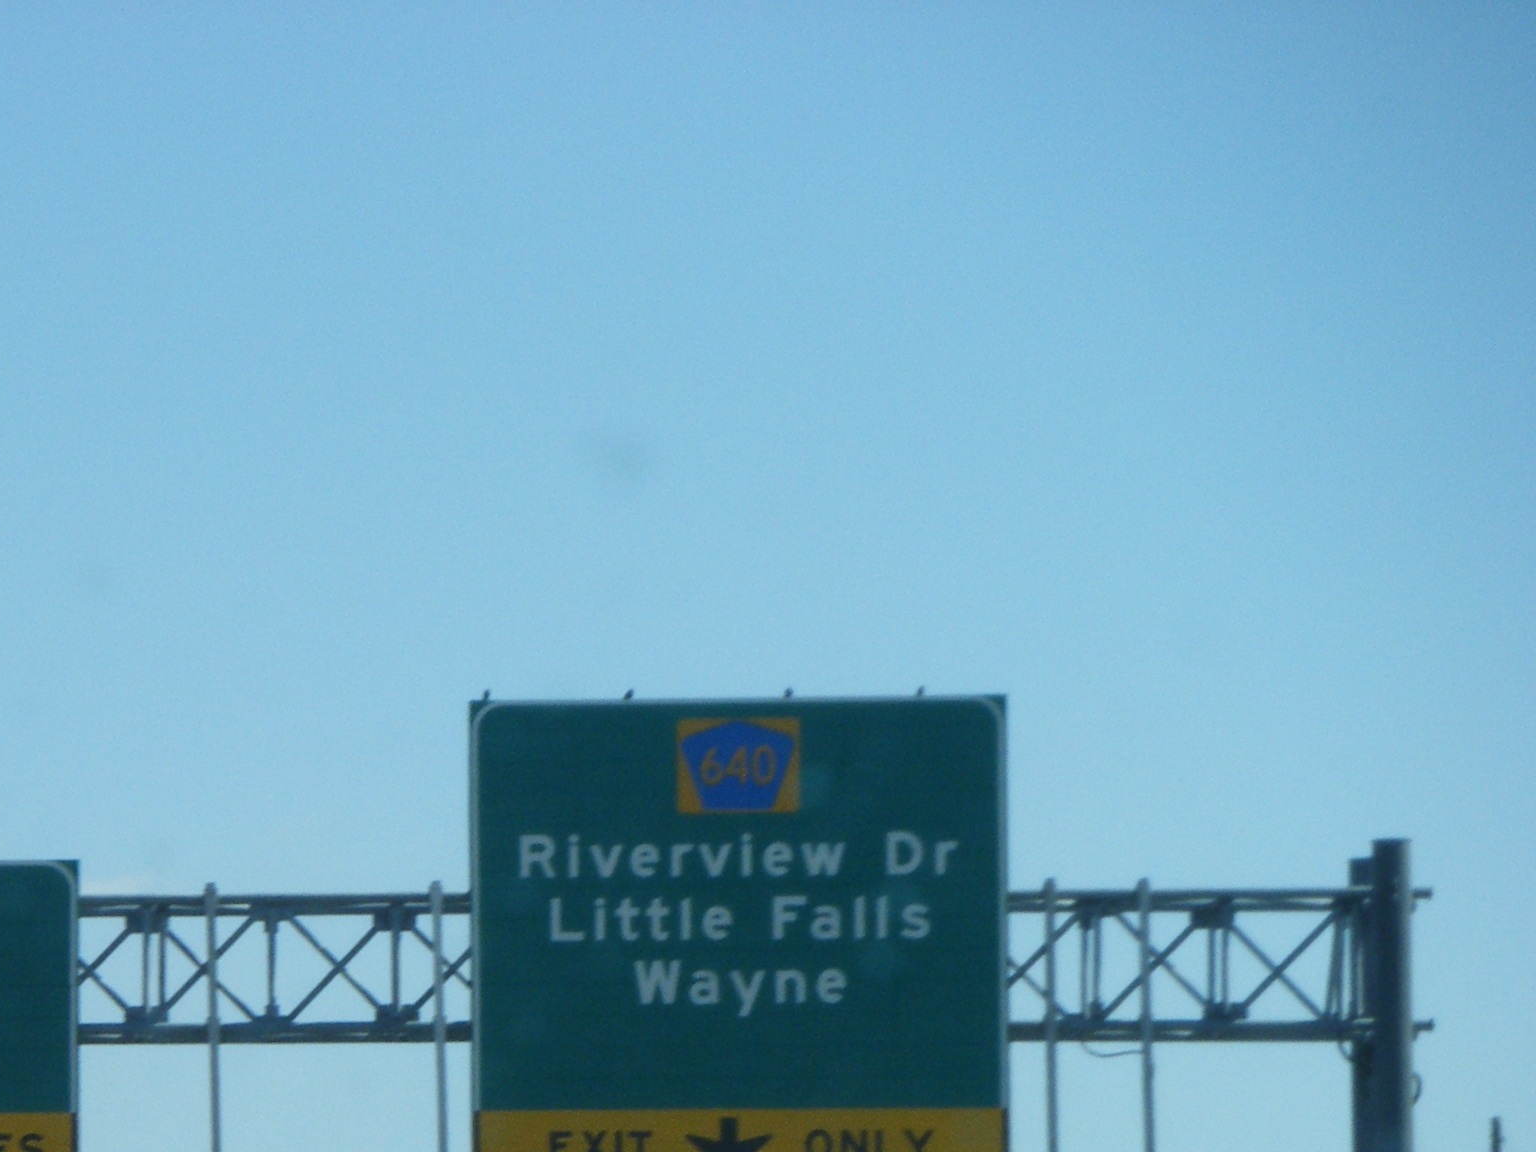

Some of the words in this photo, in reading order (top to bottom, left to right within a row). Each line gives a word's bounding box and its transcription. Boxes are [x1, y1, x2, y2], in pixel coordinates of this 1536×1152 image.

[700, 743, 776, 786] 640
[518, 832, 846, 879] Riverview
[884, 829, 959, 876] Dr
[549, 897, 734, 942] Little
[771, 895, 931, 941] Falls
[634, 958, 848, 1018] Wayne
